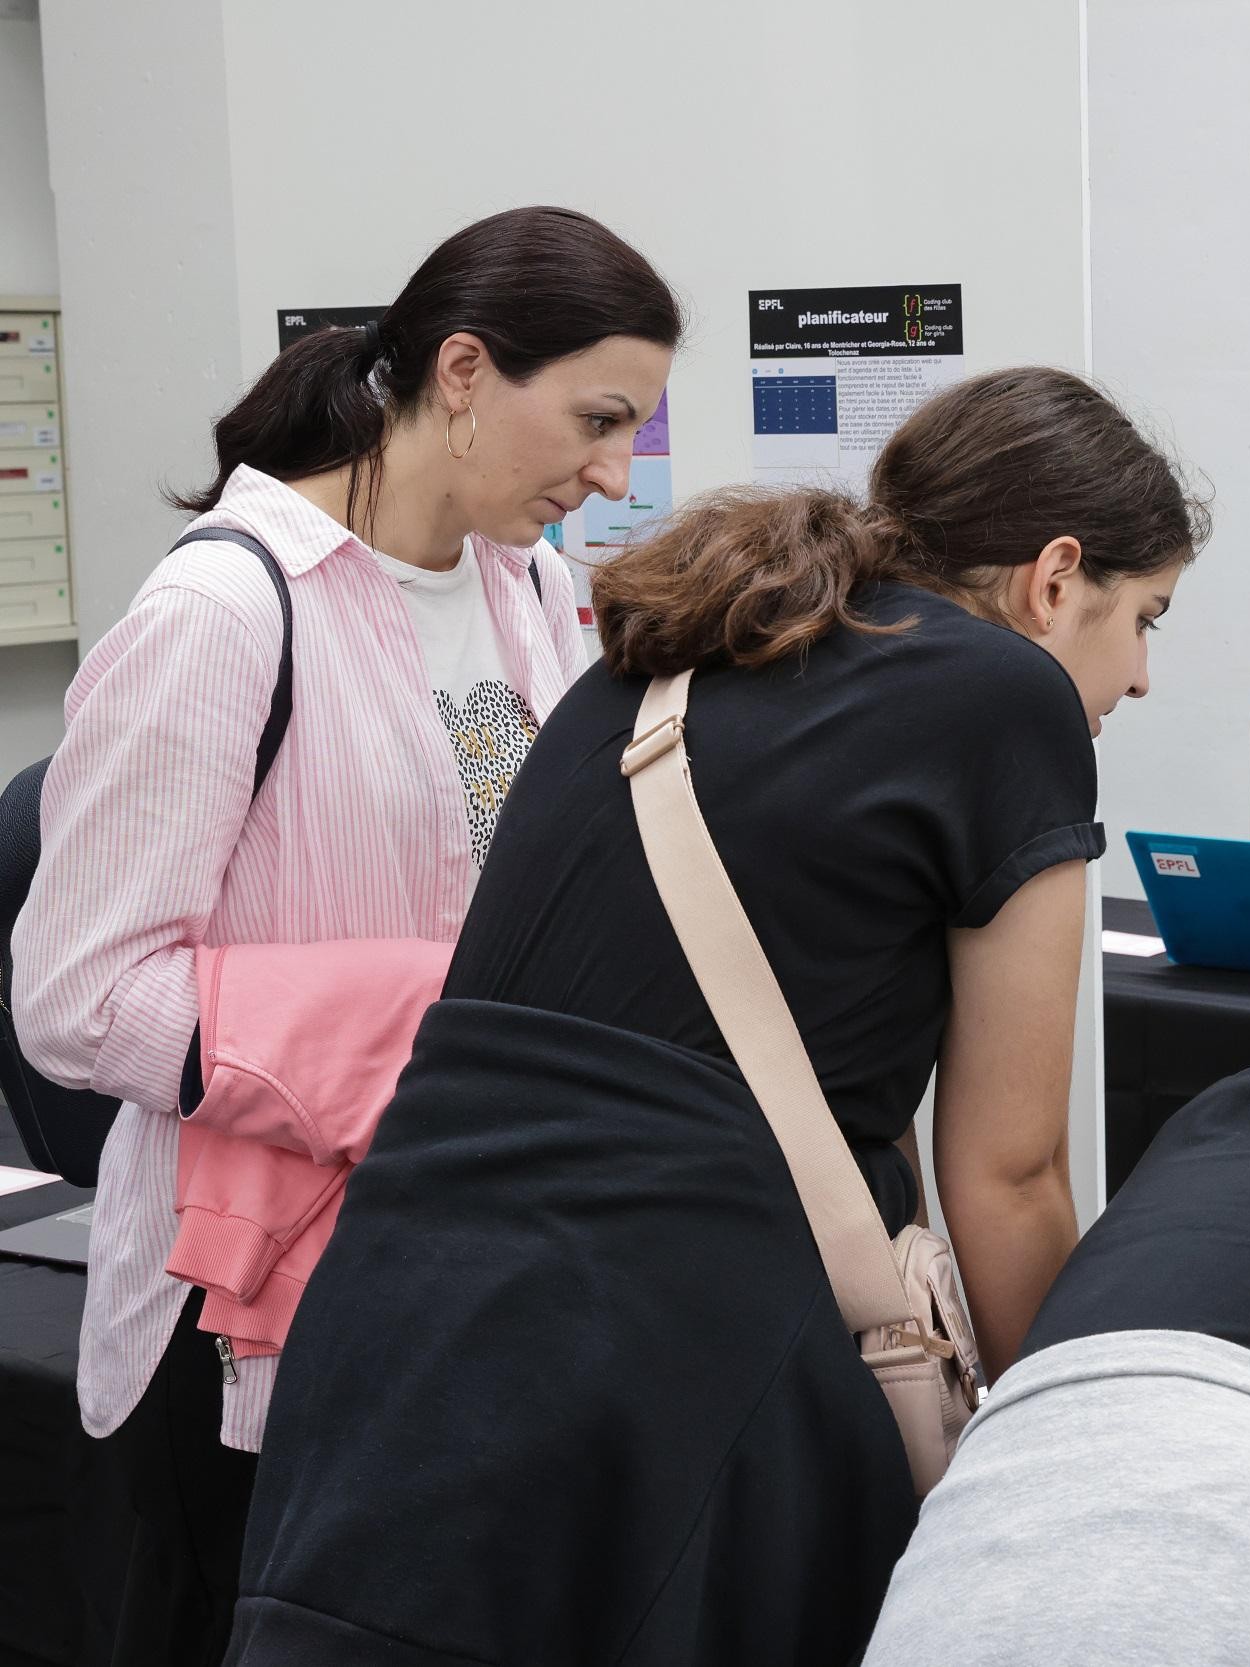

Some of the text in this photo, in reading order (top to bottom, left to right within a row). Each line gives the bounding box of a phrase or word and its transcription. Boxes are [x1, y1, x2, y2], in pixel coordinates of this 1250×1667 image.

[758, 299, 783, 310] EPFL
[285, 316, 306, 326] EPFL
[798, 310, 888, 328] planificateur
[924, 325, 941, 333] Coding
[933, 330, 944, 338] girls
[1157, 858, 1196, 872] EPFL
